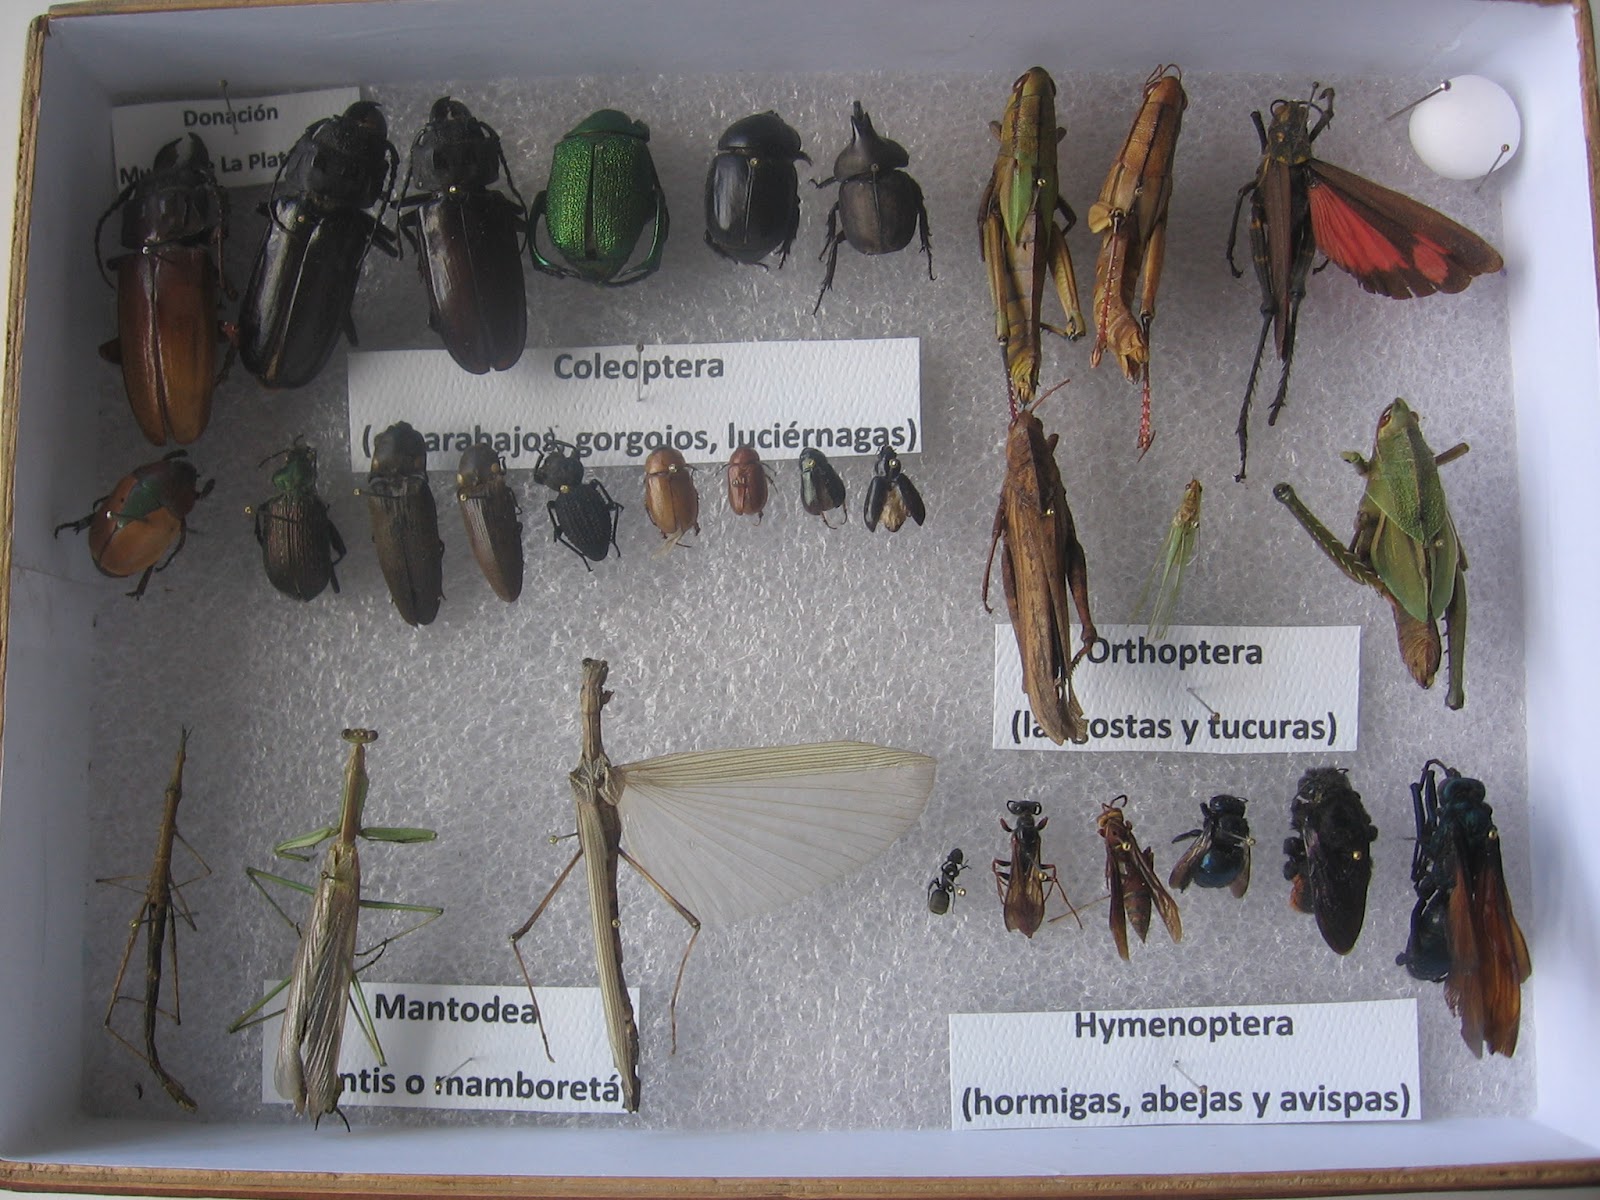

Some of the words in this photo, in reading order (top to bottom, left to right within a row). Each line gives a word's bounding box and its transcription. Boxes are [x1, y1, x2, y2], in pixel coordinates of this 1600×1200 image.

[183, 104, 279, 127] Donación
[221, 155, 243, 173] La
[249, 151, 288, 170] Plat
[553, 353, 725, 385] Coleoptera
[728, 418, 917, 453] luciérnagas)
[1086, 637, 1263, 670] Orthoptera
[1011, 710, 1172, 745] (laostas
[1181, 719, 1199, 744] y
[1208, 712, 1337, 746] tucuras)
[374, 993, 538, 1024] Mantodea
[1075, 1011, 1294, 1044] Hymenoptera
[339, 1067, 396, 1095] ntis
[405, 1074, 425, 1095] o
[434, 1073, 619, 1102] mamboretá
[962, 1087, 1132, 1122] (hormigas,
[1141, 1084, 1243, 1119] abejas
[1252, 1091, 1270, 1118] y
[1280, 1082, 1411, 1118] avispas)
